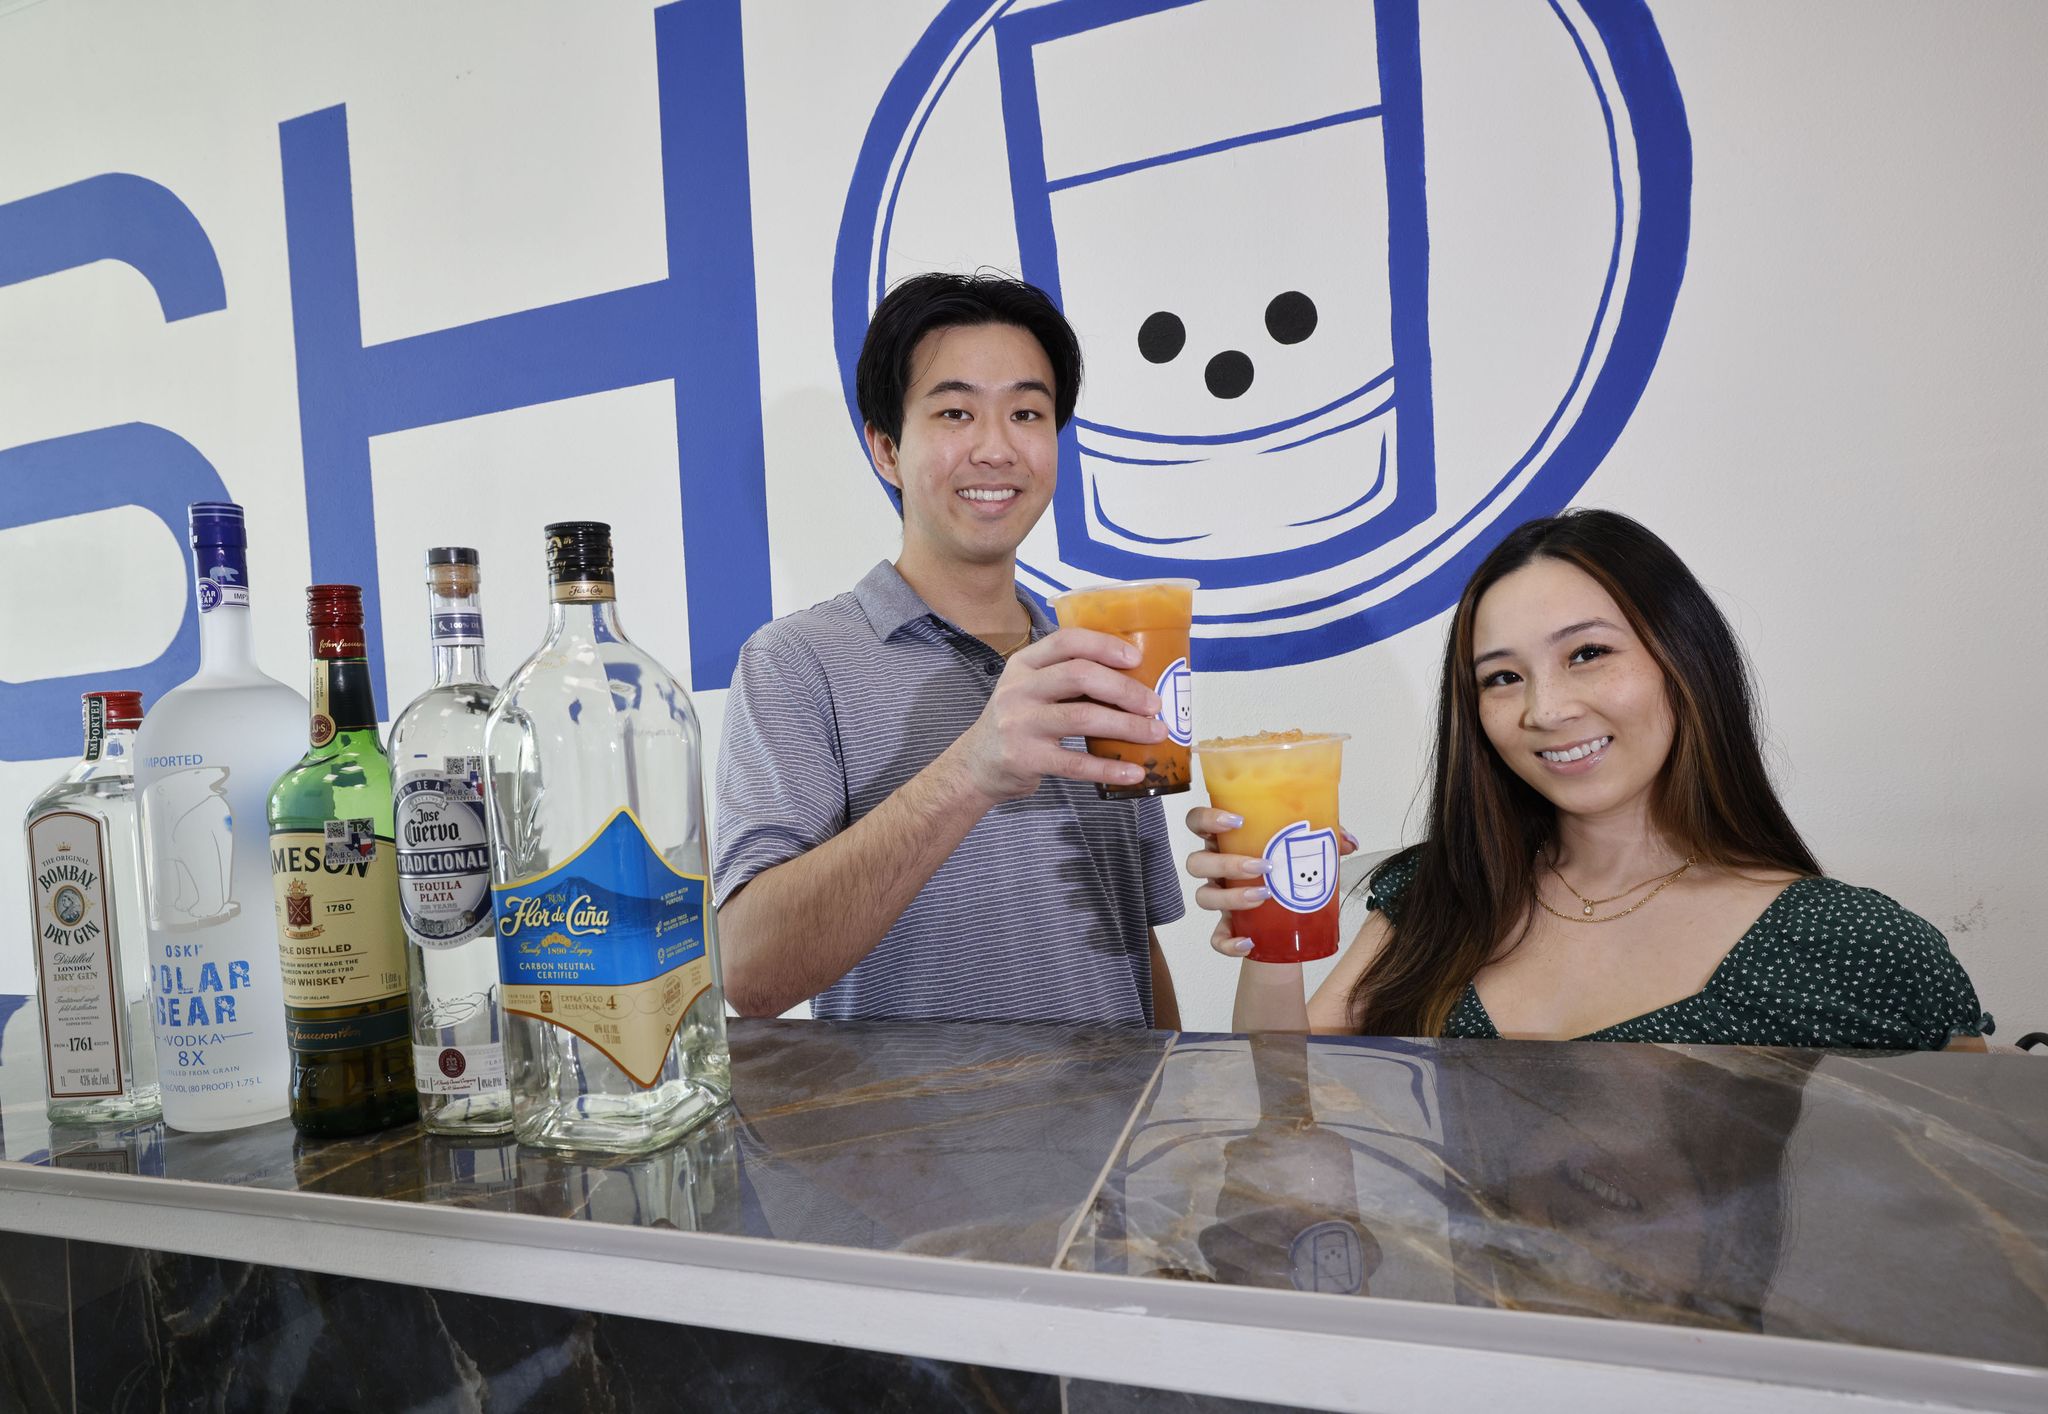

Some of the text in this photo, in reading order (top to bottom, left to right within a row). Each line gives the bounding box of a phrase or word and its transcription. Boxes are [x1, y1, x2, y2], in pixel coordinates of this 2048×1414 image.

[89, 700, 100, 756] IMPORTED
[416, 782, 428, 790] DE
[350, 820, 371, 832] TX
[404, 819, 461, 847] Cuervo
[41, 855, 89, 867] THE ORIGINAL
[397, 850, 487, 873] TRADICIONAL
[38, 865, 98, 893] BOMBAY
[413, 880, 462, 891] TEQUILA
[420, 892, 454, 902] PLATA
[326, 903, 352, 913] 1780
[500, 895, 609, 936] Flor de Caña
[44, 920, 101, 946] DRY GIN
[296, 944, 352, 955] DISTILLED
[53, 952, 95, 965] Distilled
[519, 962, 596, 971] CARBON NEUTRAL
[53, 972, 98, 982] DRY GIN
[297, 976, 346, 986] WHISKEY
[537, 971, 579, 979] CERTIFIED
[584, 995, 604, 1003] SECO
[606, 995, 617, 1010] 4
[156, 995, 237, 1027] BEAR
[69, 1037, 92, 1051] 1761
[166, 1033, 222, 1047] VODKA
[178, 1050, 205, 1067] 8X
[189, 1069, 210, 1077] FROM
[213, 1065, 241, 1075] GRAIN
[188, 1085, 200, 1094] (80
[201, 1081, 234, 1092] PROOF)
[237, 1077, 255, 1088] 1.75
[256, 1076, 263, 1085] L
